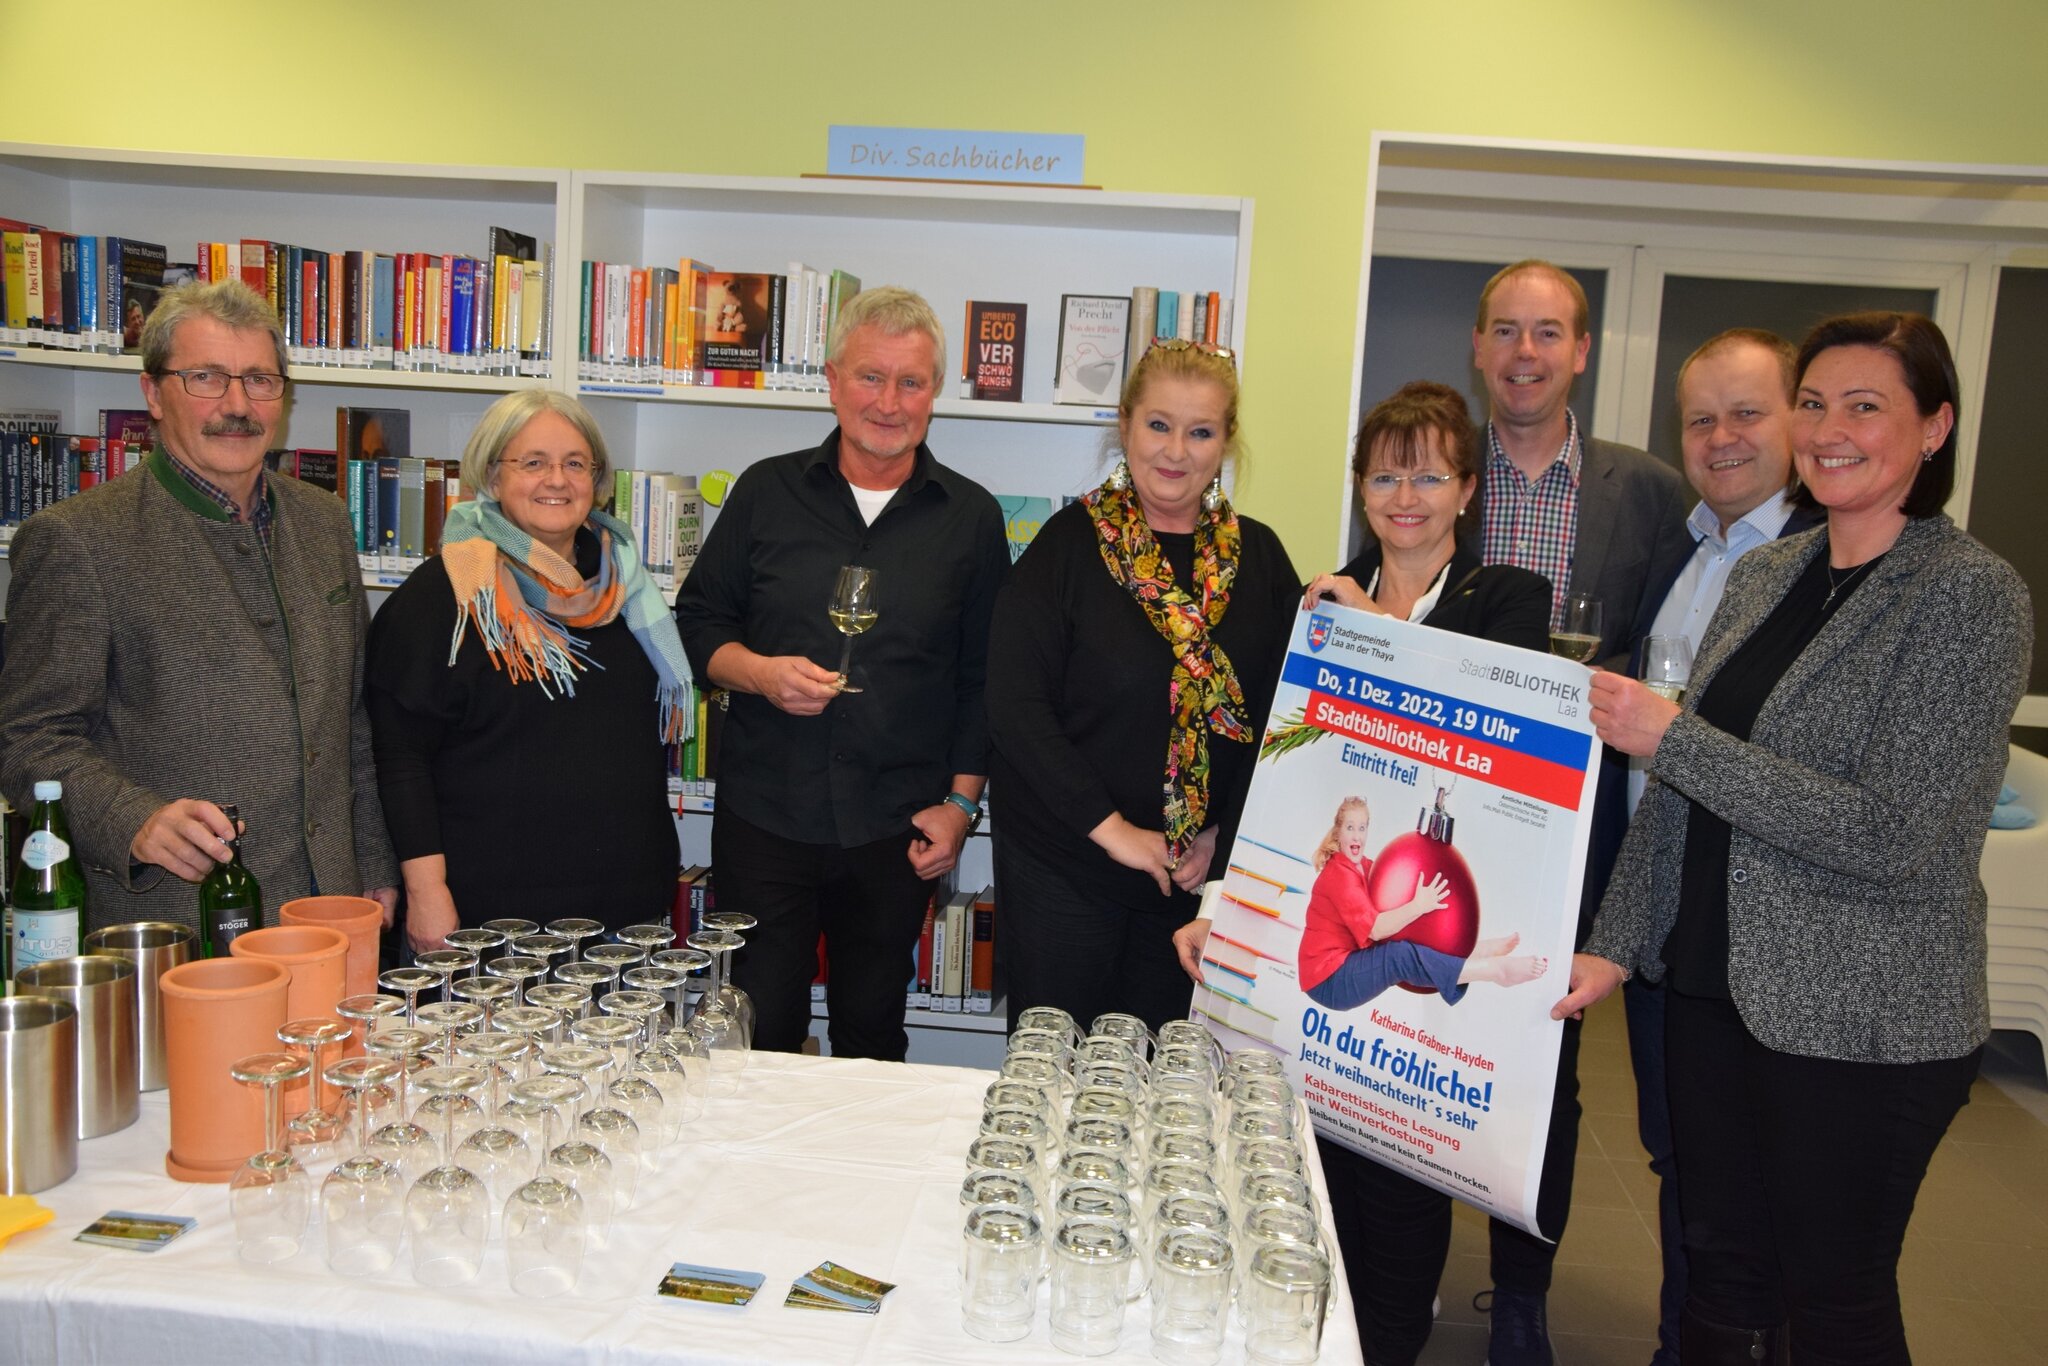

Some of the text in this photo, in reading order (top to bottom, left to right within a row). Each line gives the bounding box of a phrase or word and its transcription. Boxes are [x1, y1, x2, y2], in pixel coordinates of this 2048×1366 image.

[850, 143, 1061, 172] Div. Sachbücher
[124, 245, 166, 259] Heinz Marecek
[28, 250, 39, 296] Das Urteil
[107, 264, 115, 328] Heinz Marecek
[1071, 299, 1123, 309] Richard David
[982, 312, 1016, 321] UMBERTO
[1078, 308, 1113, 320] Precht
[980, 321, 1015, 342] ECO
[707, 347, 760, 358] ZUR GUTEN NACHT
[980, 343, 1014, 364] VER
[978, 363, 1012, 377] SCHWÖ
[977, 376, 1012, 387] RUNGEN
[21, 470, 30, 501] Schenk
[34, 488, 42, 512] chenk
[683, 503, 696, 515] DIE
[22, 502, 30, 521] Otto
[678, 516, 700, 529] BURN
[680, 531, 697, 543] OUT
[677, 543, 698, 558] LÜGE
[1333, 626, 1391, 648] Stadtgemeinde
[1331, 637, 1395, 662] Laa an der Thaya
[1458, 658, 1581, 703] StadtBIBLIOTHEK
[1317, 667, 1520, 743] Do, 1 Dez. 2022, 19 Uhr
[1557, 700, 1578, 718] Laa
[1315, 701, 1492, 775] Stadtbibliothek Laa
[1341, 742, 1419, 787] Eintritt frei!
[219, 921, 248, 930] STÖGER
[1370, 1008, 1495, 1072] Katharina Grabner-Hayden
[1301, 1007, 1493, 1113] Oh du fröhliche!
[1299, 1042, 1331, 1071] Jetzt
[1446, 1106, 1478, 1132] sehr
[1304, 1073, 1461, 1151] Kabarettistische Lesung
[1304, 1088, 1435, 1155] mit Weinverkostung
[1308, 1105, 1338, 1126] bleiben
[1339, 1118, 1356, 1134] kein
[1358, 1127, 1379, 1144] Auge
[1380, 1138, 1396, 1151] und
[1397, 1145, 1416, 1160] kein
[1417, 1154, 1452, 1176] Gaumen
[1454, 1171, 1492, 1194] trocken.
